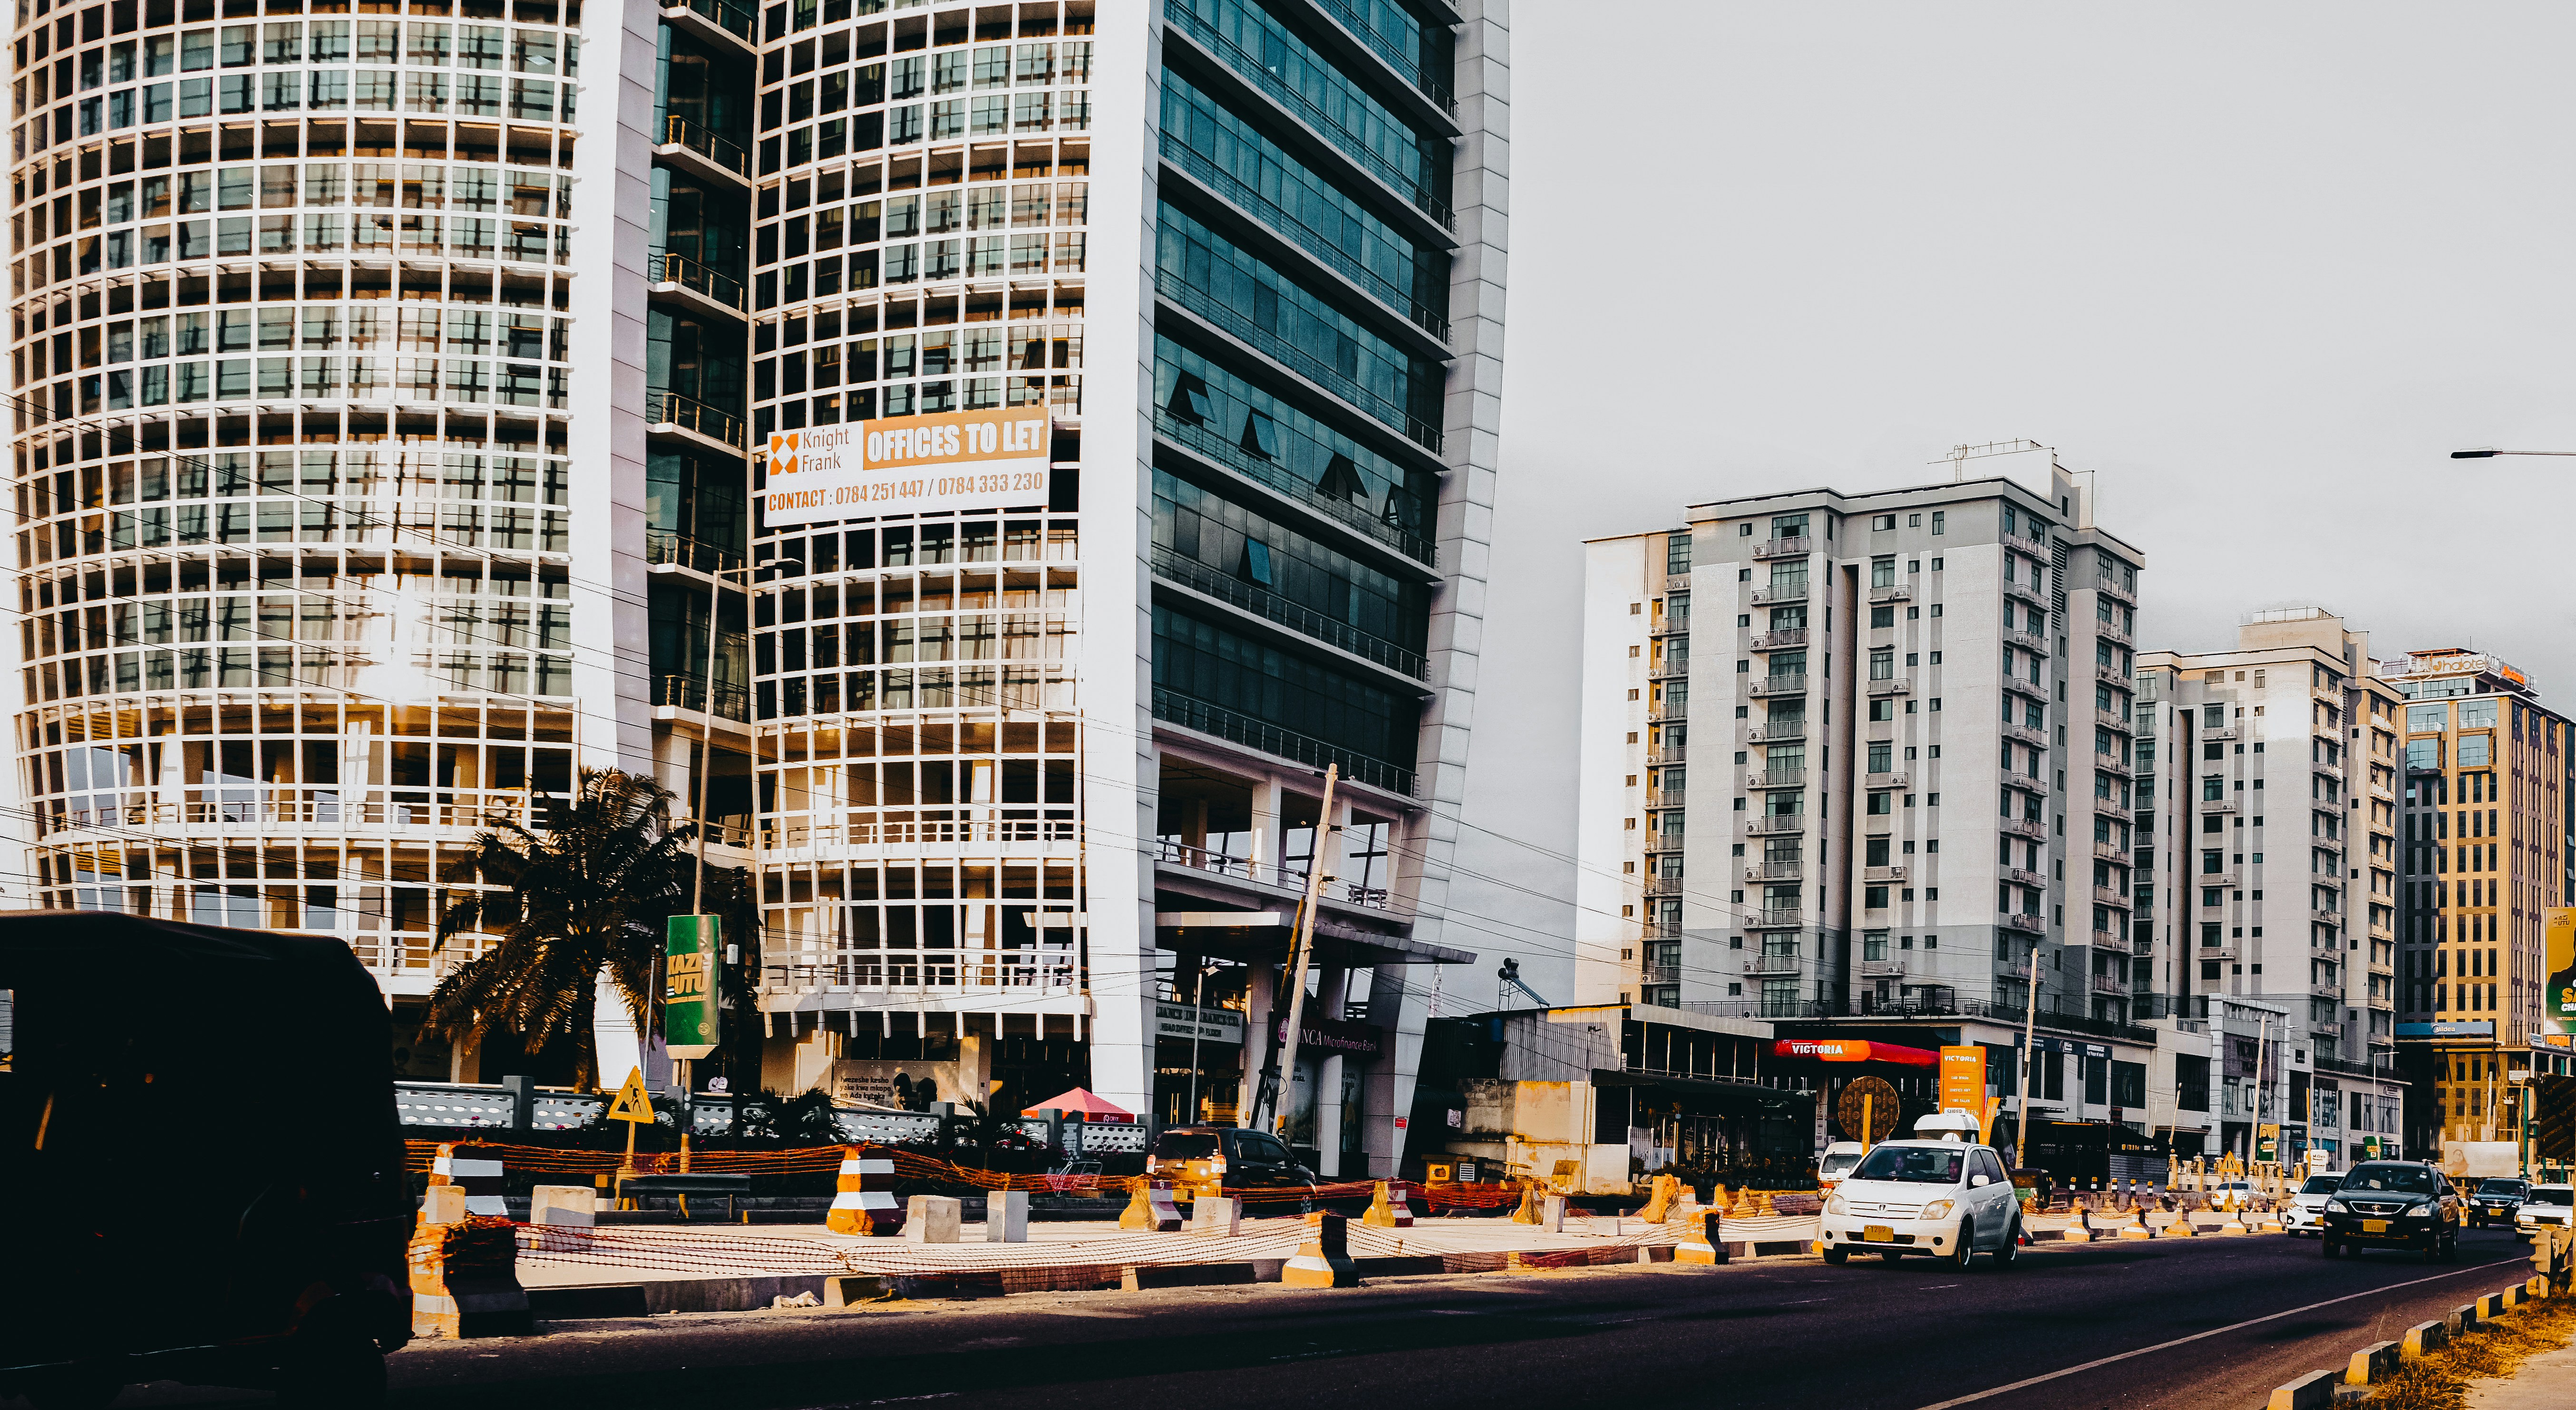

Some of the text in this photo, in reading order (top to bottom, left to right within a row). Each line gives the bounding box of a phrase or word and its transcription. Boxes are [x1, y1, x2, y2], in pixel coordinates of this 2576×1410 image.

[803, 428, 849, 451] Knight
[867, 419, 1043, 463] OFFICES TO LET
[802, 452, 841, 473] Frank
[769, 489, 826, 511] CONTACT
[836, 484, 867, 505] 0784
[872, 482, 896, 502] 251
[899, 480, 923, 499] 447
[927, 478, 934, 497] /
[939, 476, 974, 496] 0784
[979, 474, 1009, 493] 333
[1013, 472, 1043, 491] 230
[668, 953, 703, 975] KAZI
[1297, 1028, 1377, 1052] INCA Microfinance Bank
[1792, 1045, 1843, 1054] VICTORIA
